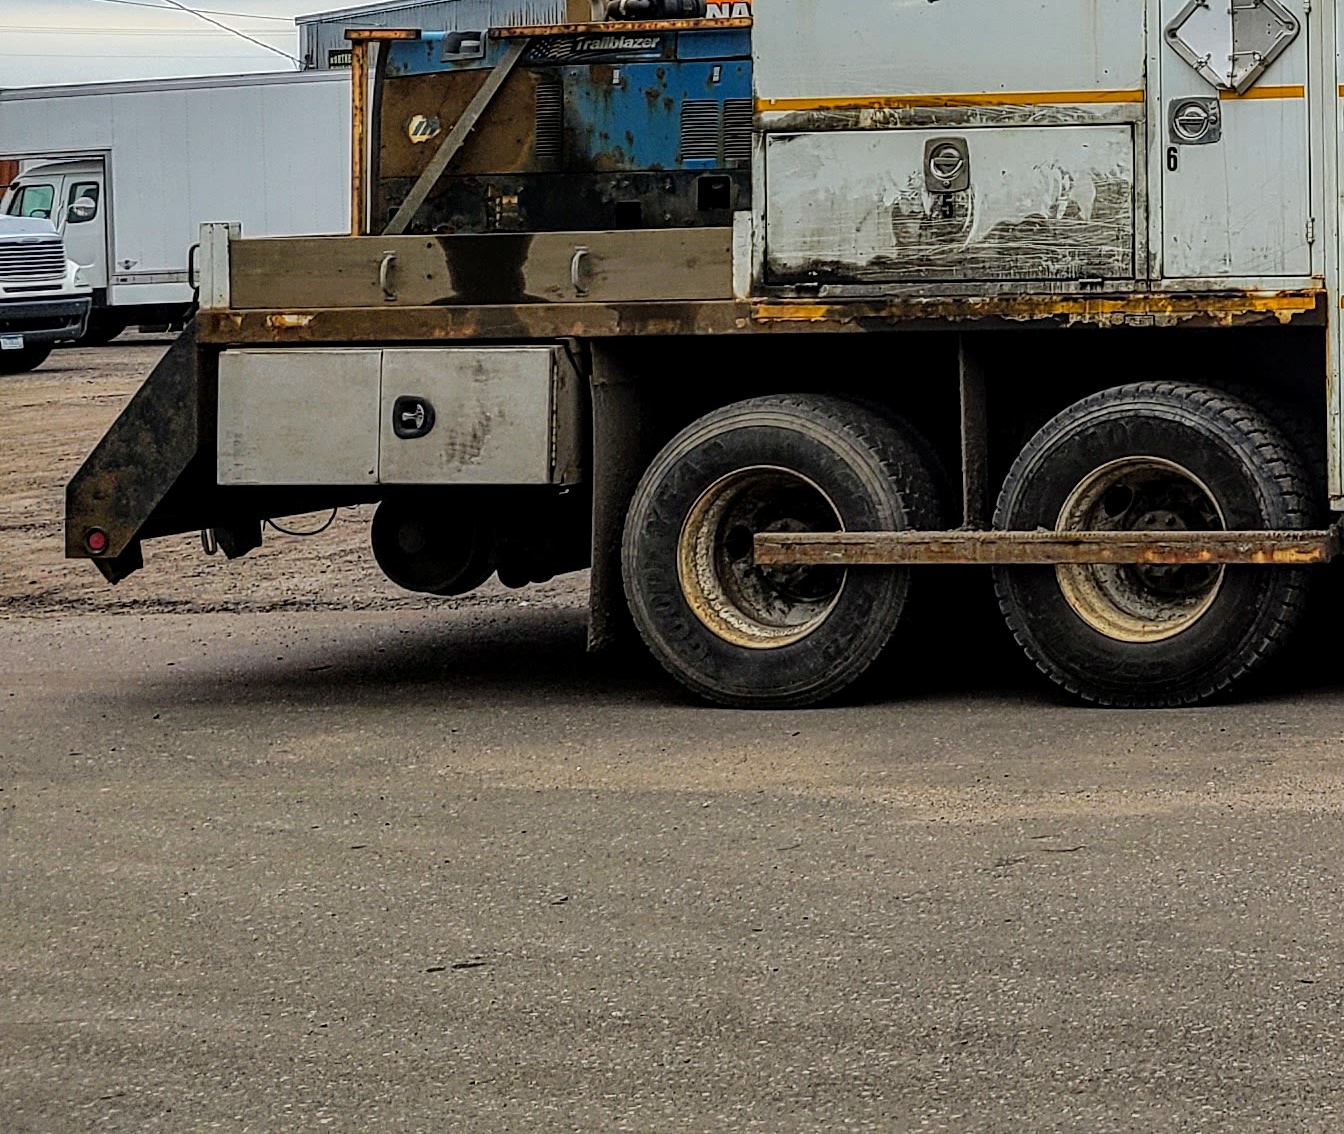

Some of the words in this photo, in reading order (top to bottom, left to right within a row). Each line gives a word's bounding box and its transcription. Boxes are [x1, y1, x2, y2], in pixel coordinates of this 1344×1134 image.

[576, 36, 661, 52] Trailblazer
[1166, 146, 1178, 172] 6
[942, 194, 953, 218] 5
